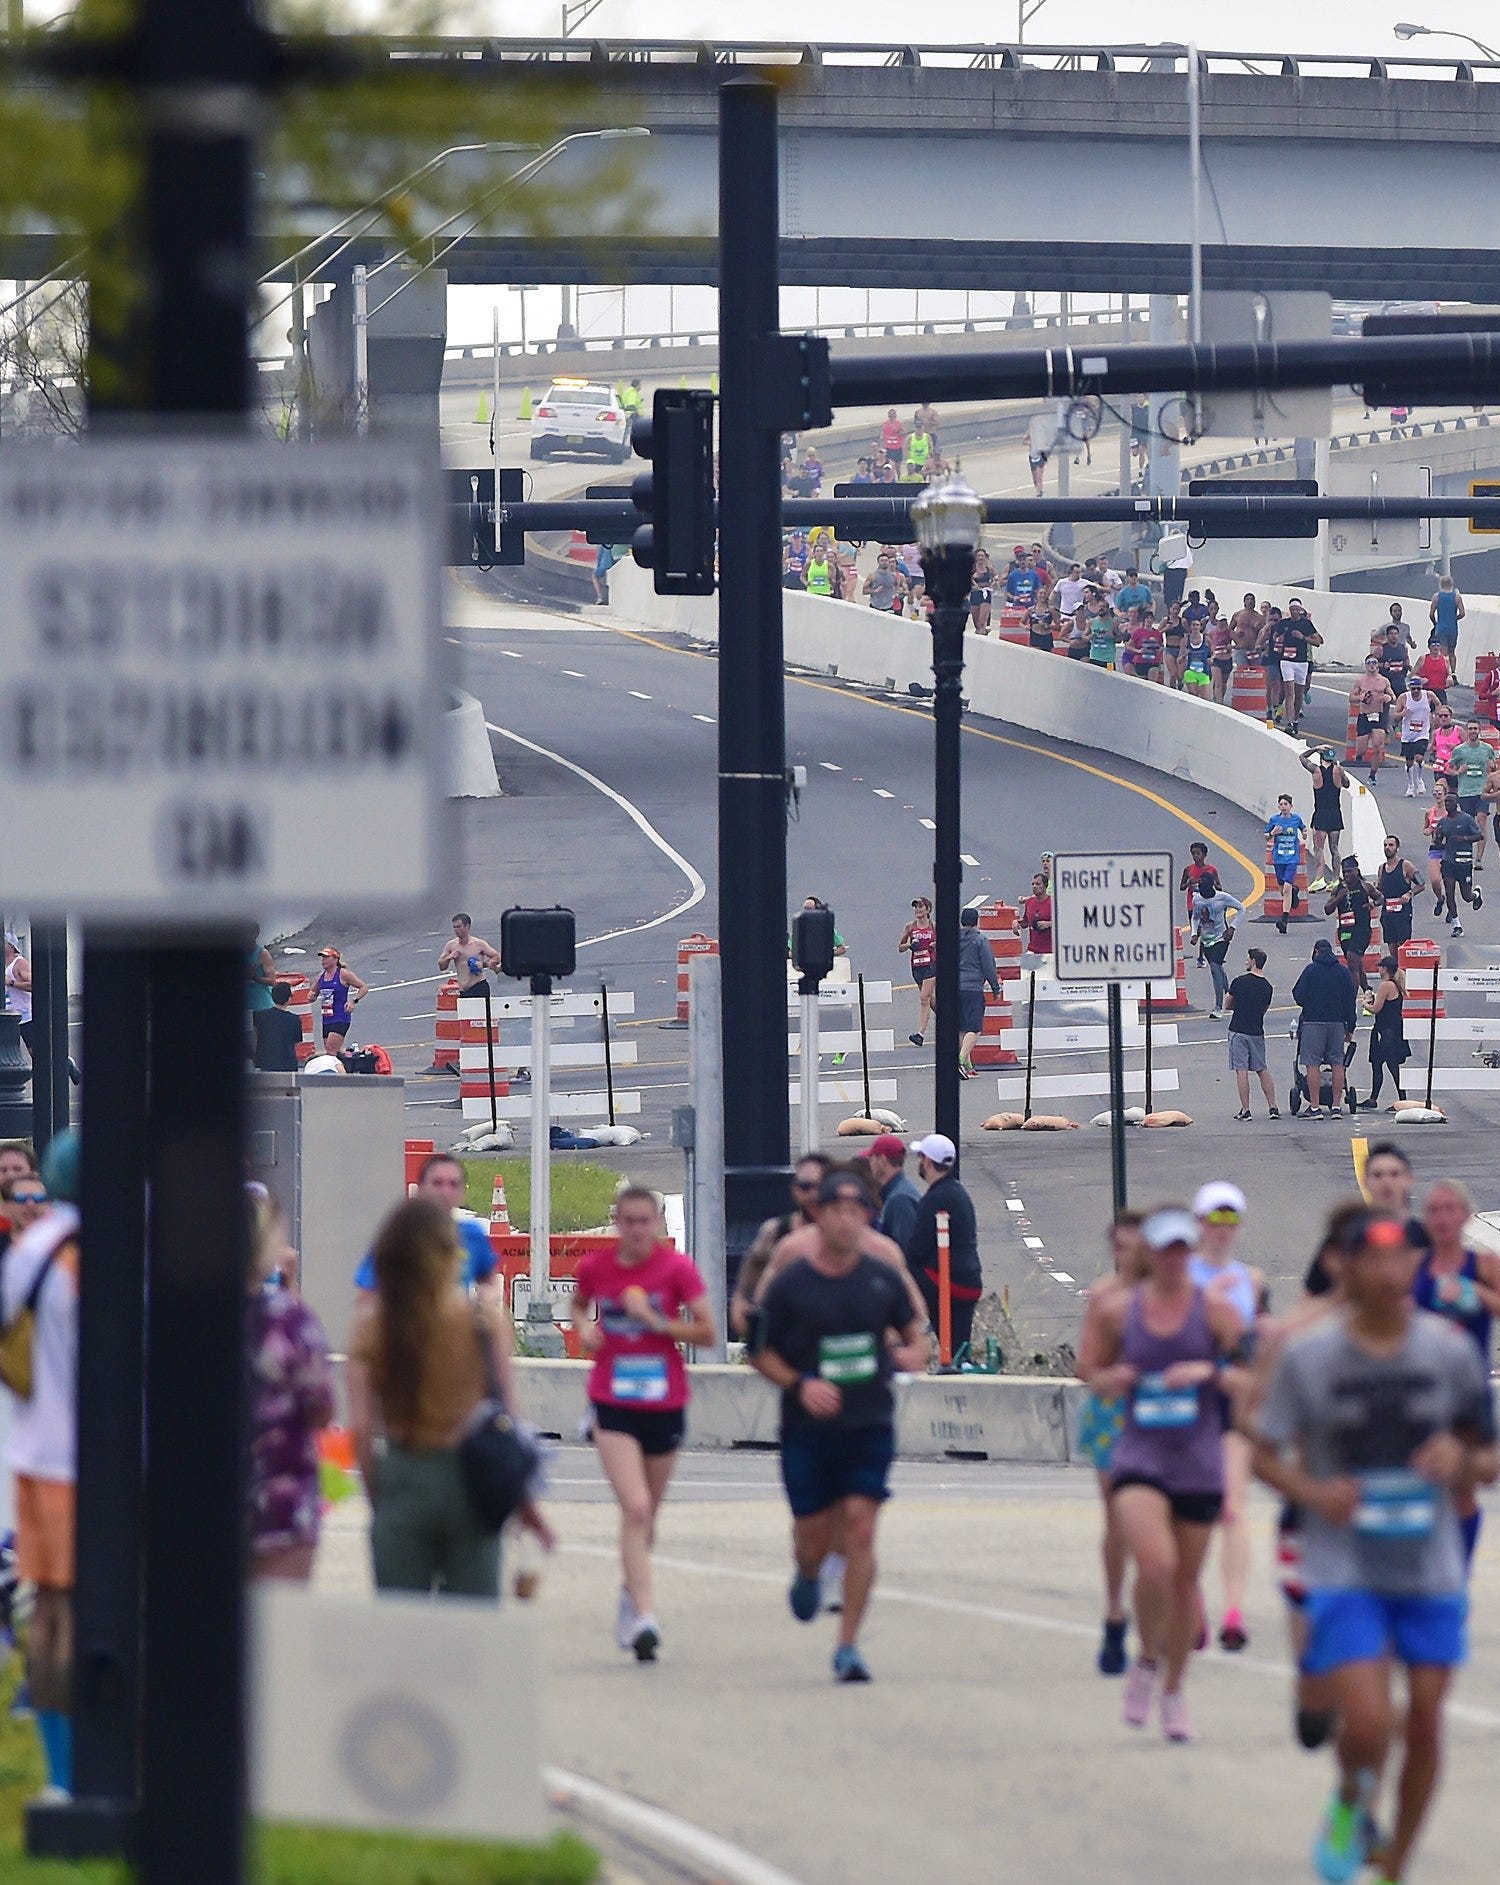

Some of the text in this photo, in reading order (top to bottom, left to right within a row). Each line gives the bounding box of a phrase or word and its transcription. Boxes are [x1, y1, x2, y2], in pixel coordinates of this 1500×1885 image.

[1062, 868, 1164, 889] RIGHT LANE
[1083, 904, 1144, 928] MUST
[1063, 943, 1166, 963] TURN RIGHT
